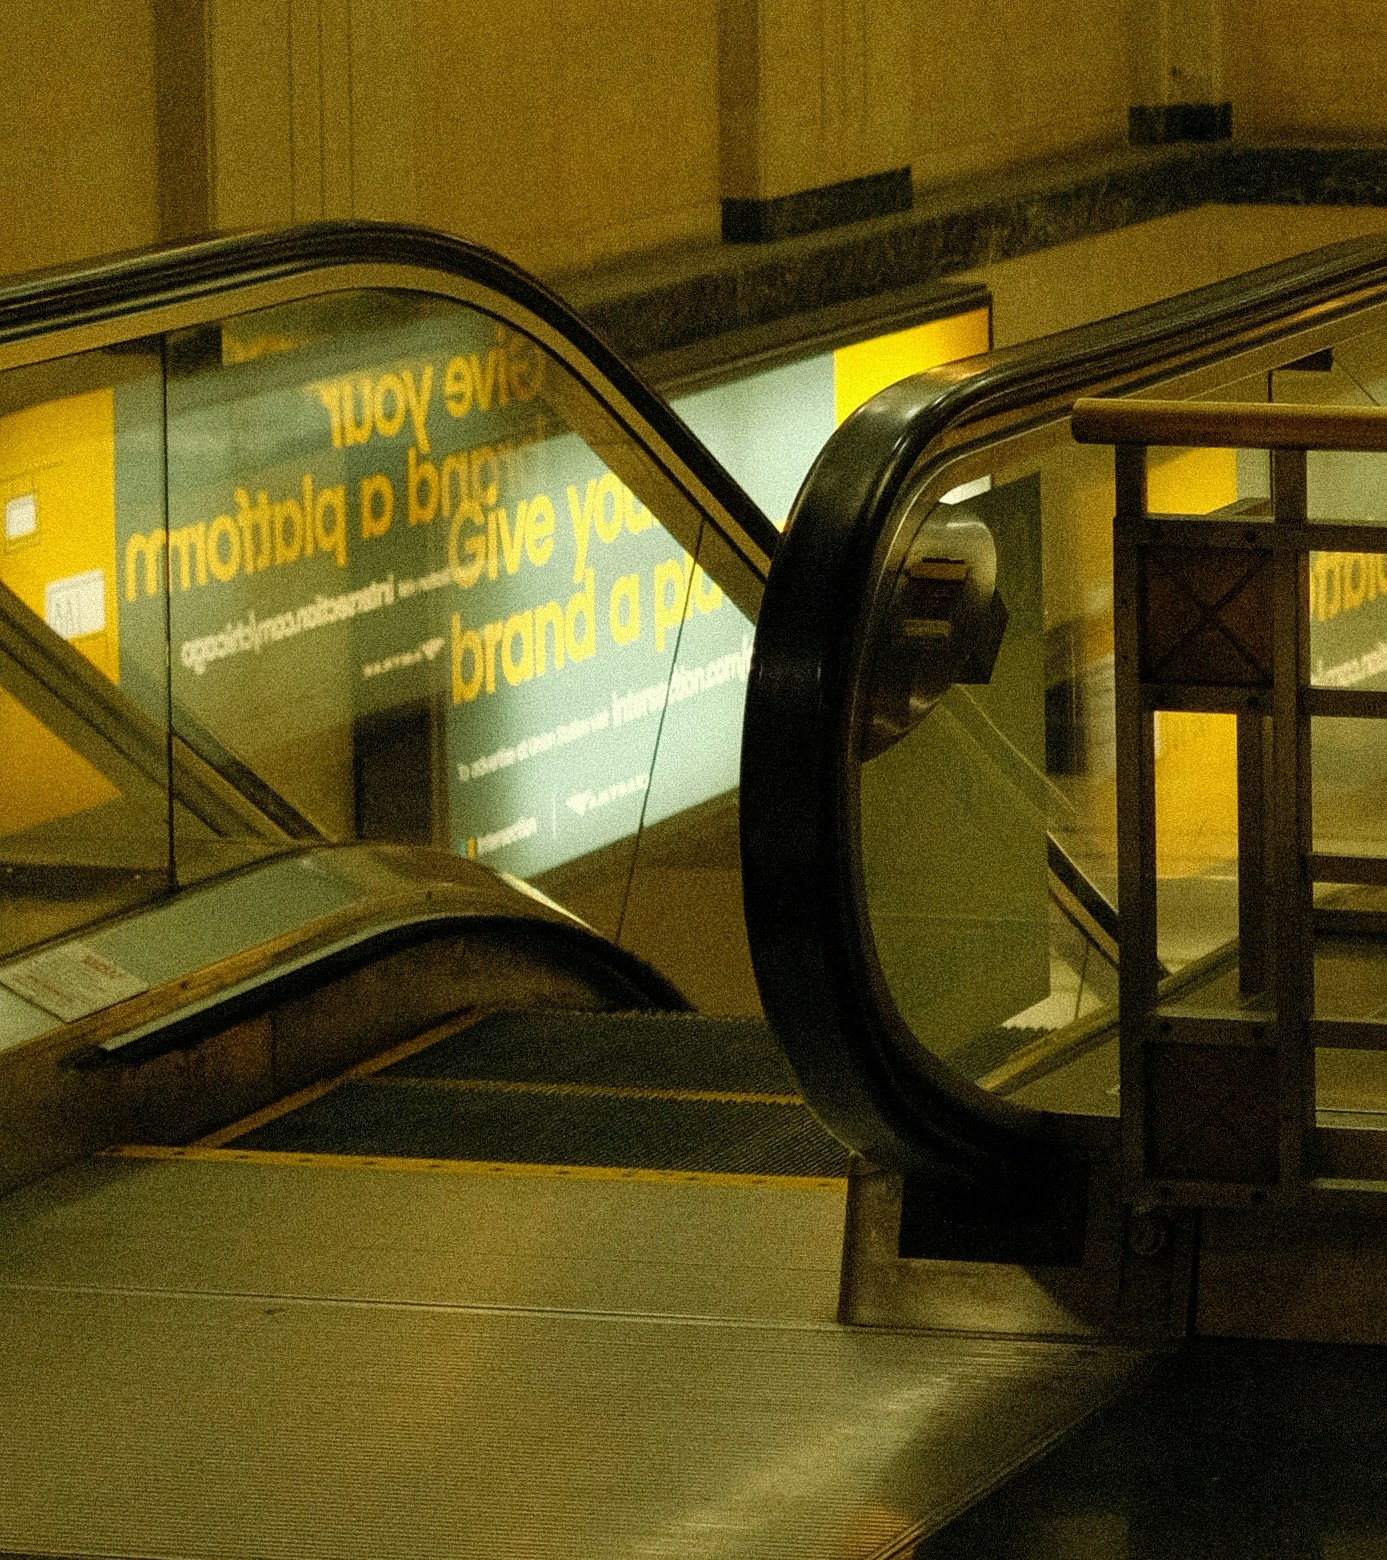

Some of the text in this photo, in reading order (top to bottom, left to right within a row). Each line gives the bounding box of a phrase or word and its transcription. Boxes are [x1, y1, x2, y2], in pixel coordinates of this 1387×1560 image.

[450, 472, 660, 589] Give you
[450, 566, 597, 705] brand
[609, 572, 640, 647] a
